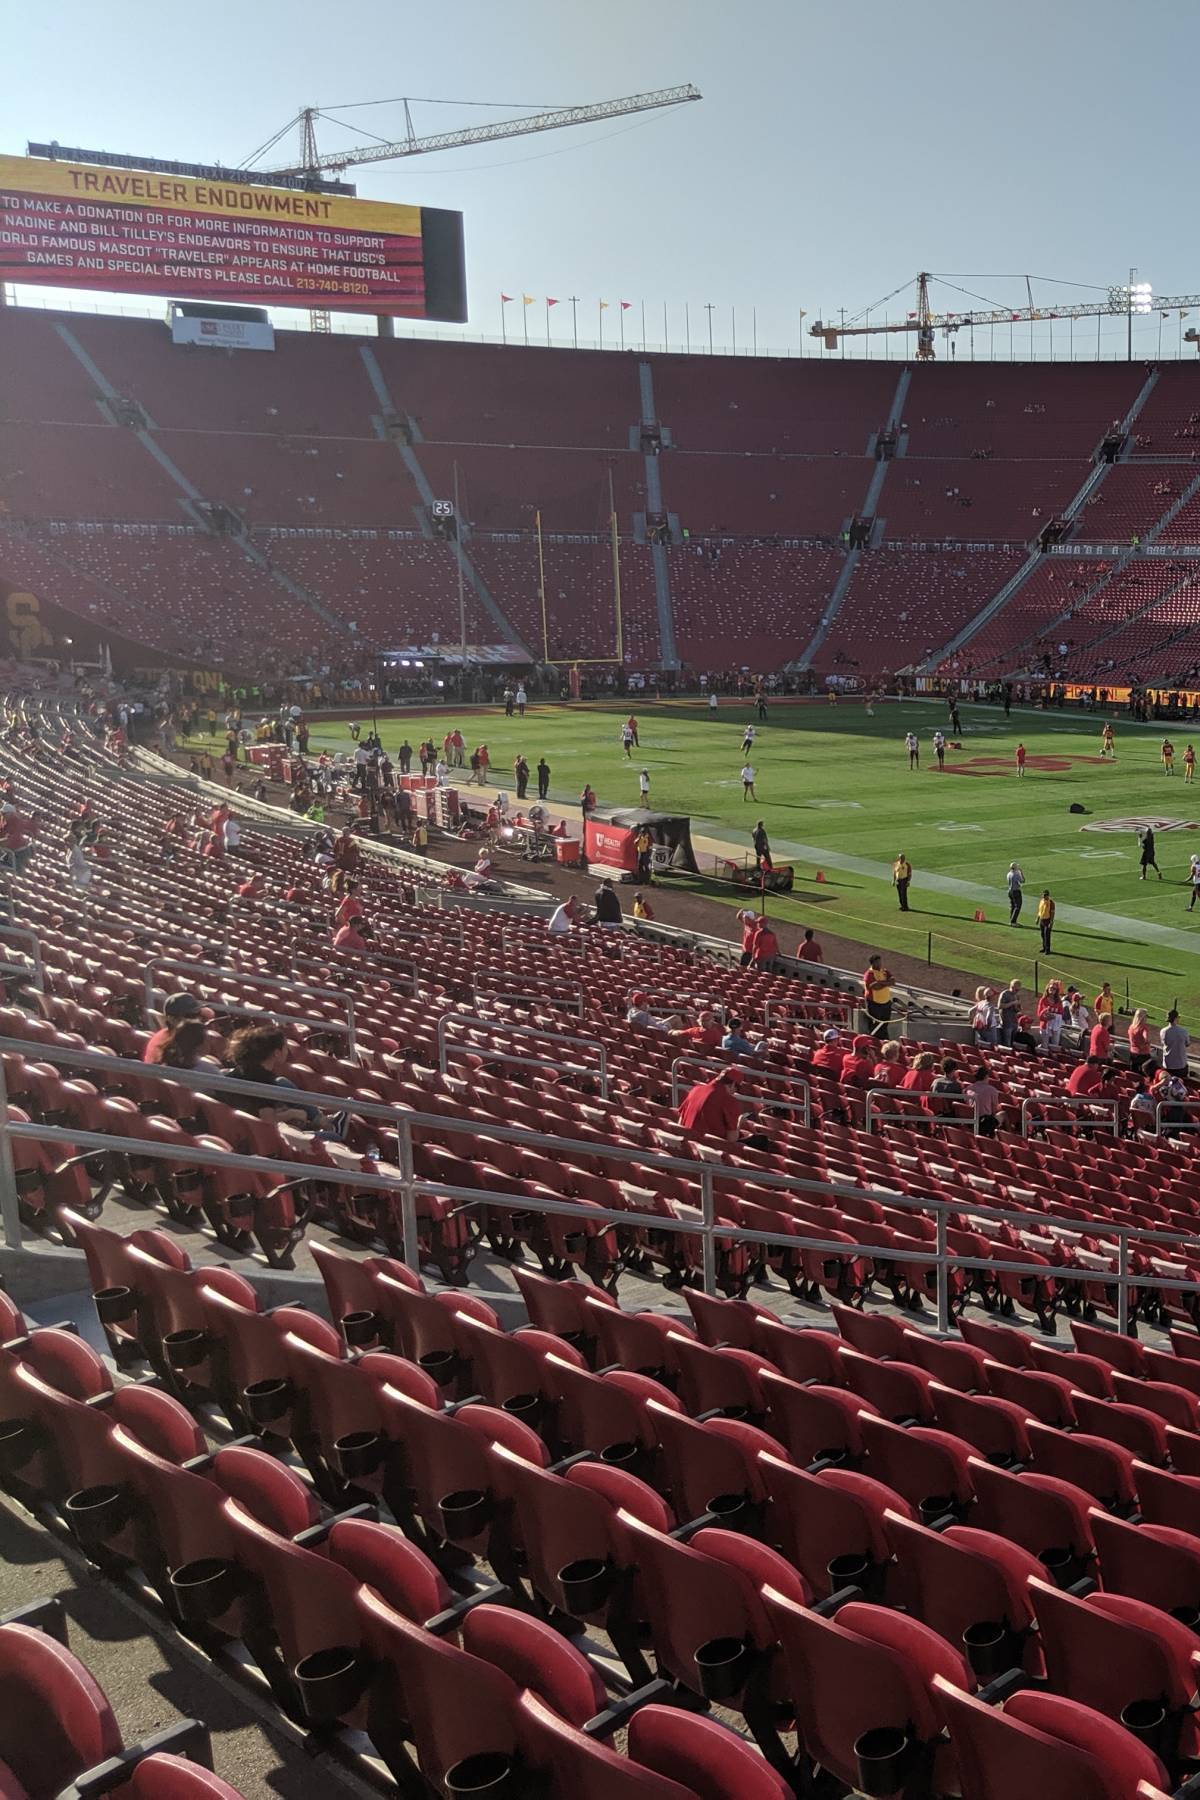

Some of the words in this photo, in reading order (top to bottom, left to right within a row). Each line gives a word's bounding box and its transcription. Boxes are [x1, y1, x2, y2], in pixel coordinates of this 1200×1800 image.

[68, 170, 188, 202] TRAVELER
[195, 186, 332, 218] ENDOWMENT
[1, 196, 20, 208] TO
[24, 199, 61, 213] MAKE
[65, 204, 74, 215] A
[78, 205, 142, 222] DONATION
[147, 213, 163, 225] OR
[168, 215, 192, 228] FOR
[196, 218, 230, 232] MORE
[233, 222, 313, 241] INFORMATION
[316, 231, 331, 243] TO
[334, 233, 386, 249] SUPPORT
[5, 215, 56, 230] NADINE
[60, 221, 87, 233] AND
[91, 224, 119, 237] BILL
[122, 227, 175, 243] TILLEY'S
[179, 233, 251, 251] ENDEAVORS
[254, 241, 269, 253] TO
[272, 243, 318, 258] ENSURE
[321, 248, 351, 261] THAT
[353, 252, 386, 265] USC'S
[27, 251, 74, 267] GAMES
[77, 257, 104, 270] AND
[107, 260, 161, 276] SPECIAL
[164, 265, 212, 280] EVENTS
[215, 270, 261, 285] PLEASE
[264, 275, 294, 288] CALL
[42, 236, 96, 252] FAMOUS
[100, 242, 152, 257] MASCOT
[155, 247, 229, 265] "TRAVELER"
[232, 255, 287, 271] APPEARS
[290, 261, 305, 273] AT
[307, 263, 340, 277] HOME
[343, 266, 400, 283] FOOTBALL
[435, 502, 450, 514] 25
